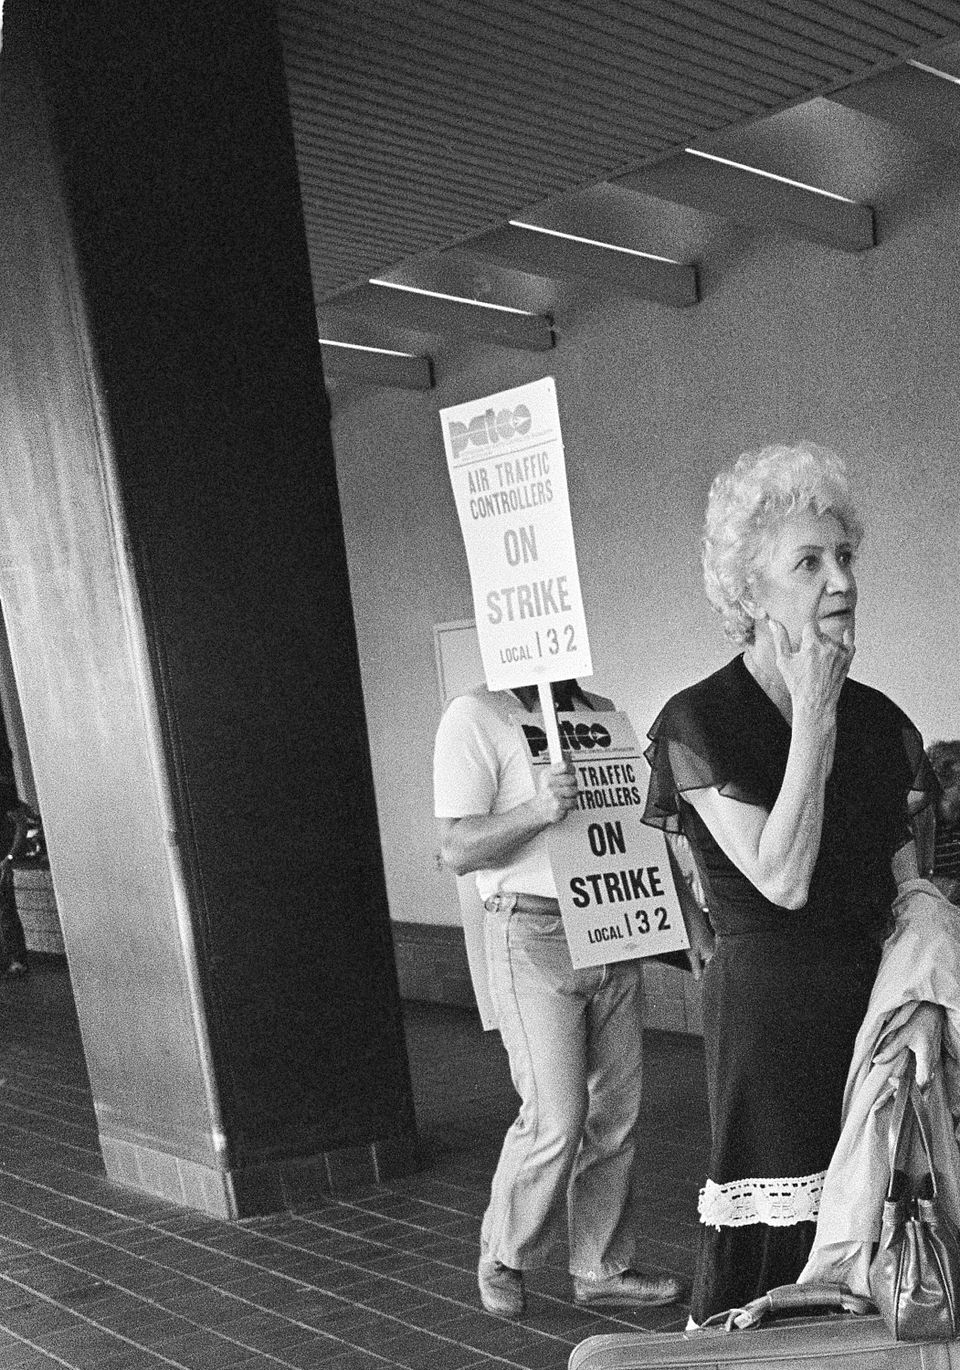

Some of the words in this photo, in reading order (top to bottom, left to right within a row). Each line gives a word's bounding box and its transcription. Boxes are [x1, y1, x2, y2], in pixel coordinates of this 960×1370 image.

[449, 404, 532, 459] patco
[467, 468, 489, 495] AIR
[495, 451, 550, 487] TRAFFIC
[470, 479, 553, 520] CONTROLLERS
[503, 525, 538, 566] ON
[486, 575, 572, 624] STRIKE
[500, 645, 533, 663] LOCAL
[578, 764, 636, 787] TRAFFIC
[576, 786, 641, 810] TROLLERS
[587, 821, 626, 857] ON
[569, 866, 665, 908] STRIKE
[587, 925, 624, 944] LOCAL
